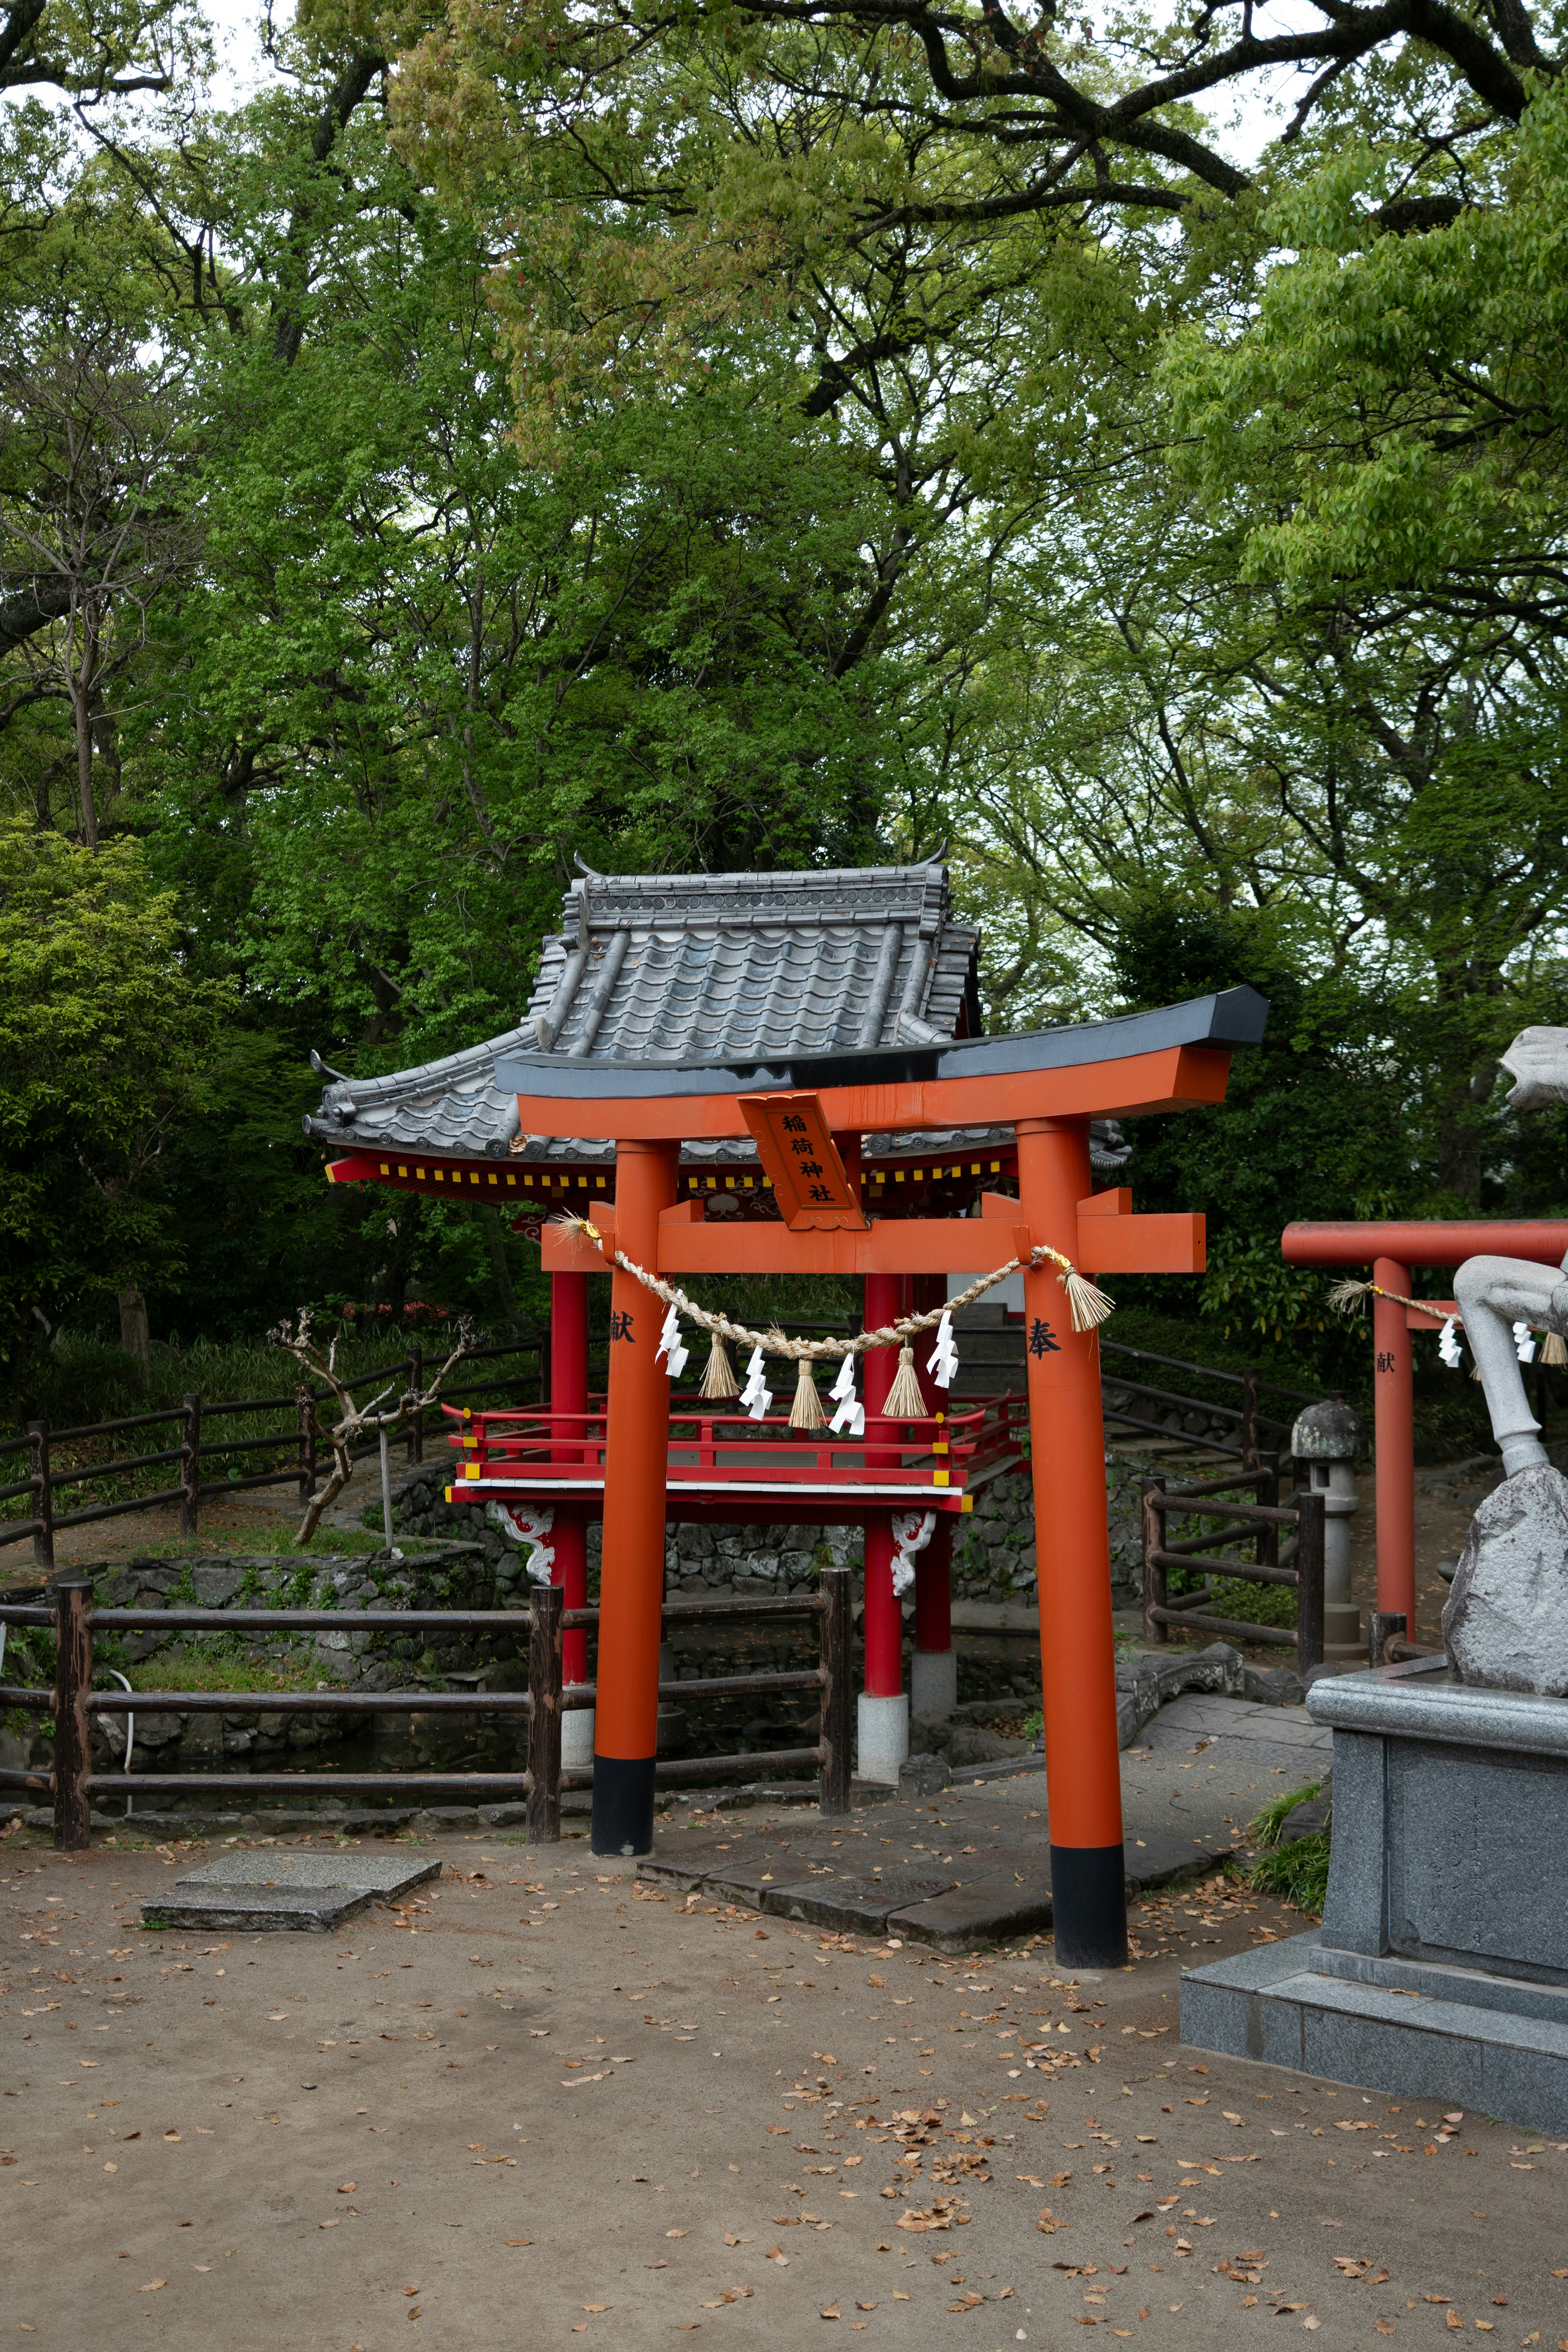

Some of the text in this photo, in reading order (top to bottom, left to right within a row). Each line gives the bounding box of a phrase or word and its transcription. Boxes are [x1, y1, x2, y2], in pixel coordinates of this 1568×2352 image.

[781, 1115, 836, 1202] 稲荷神社
[611, 1310, 636, 1343] 献
[1028, 1318, 1062, 1361] 奉
[1377, 1352, 1395, 1373] 献
